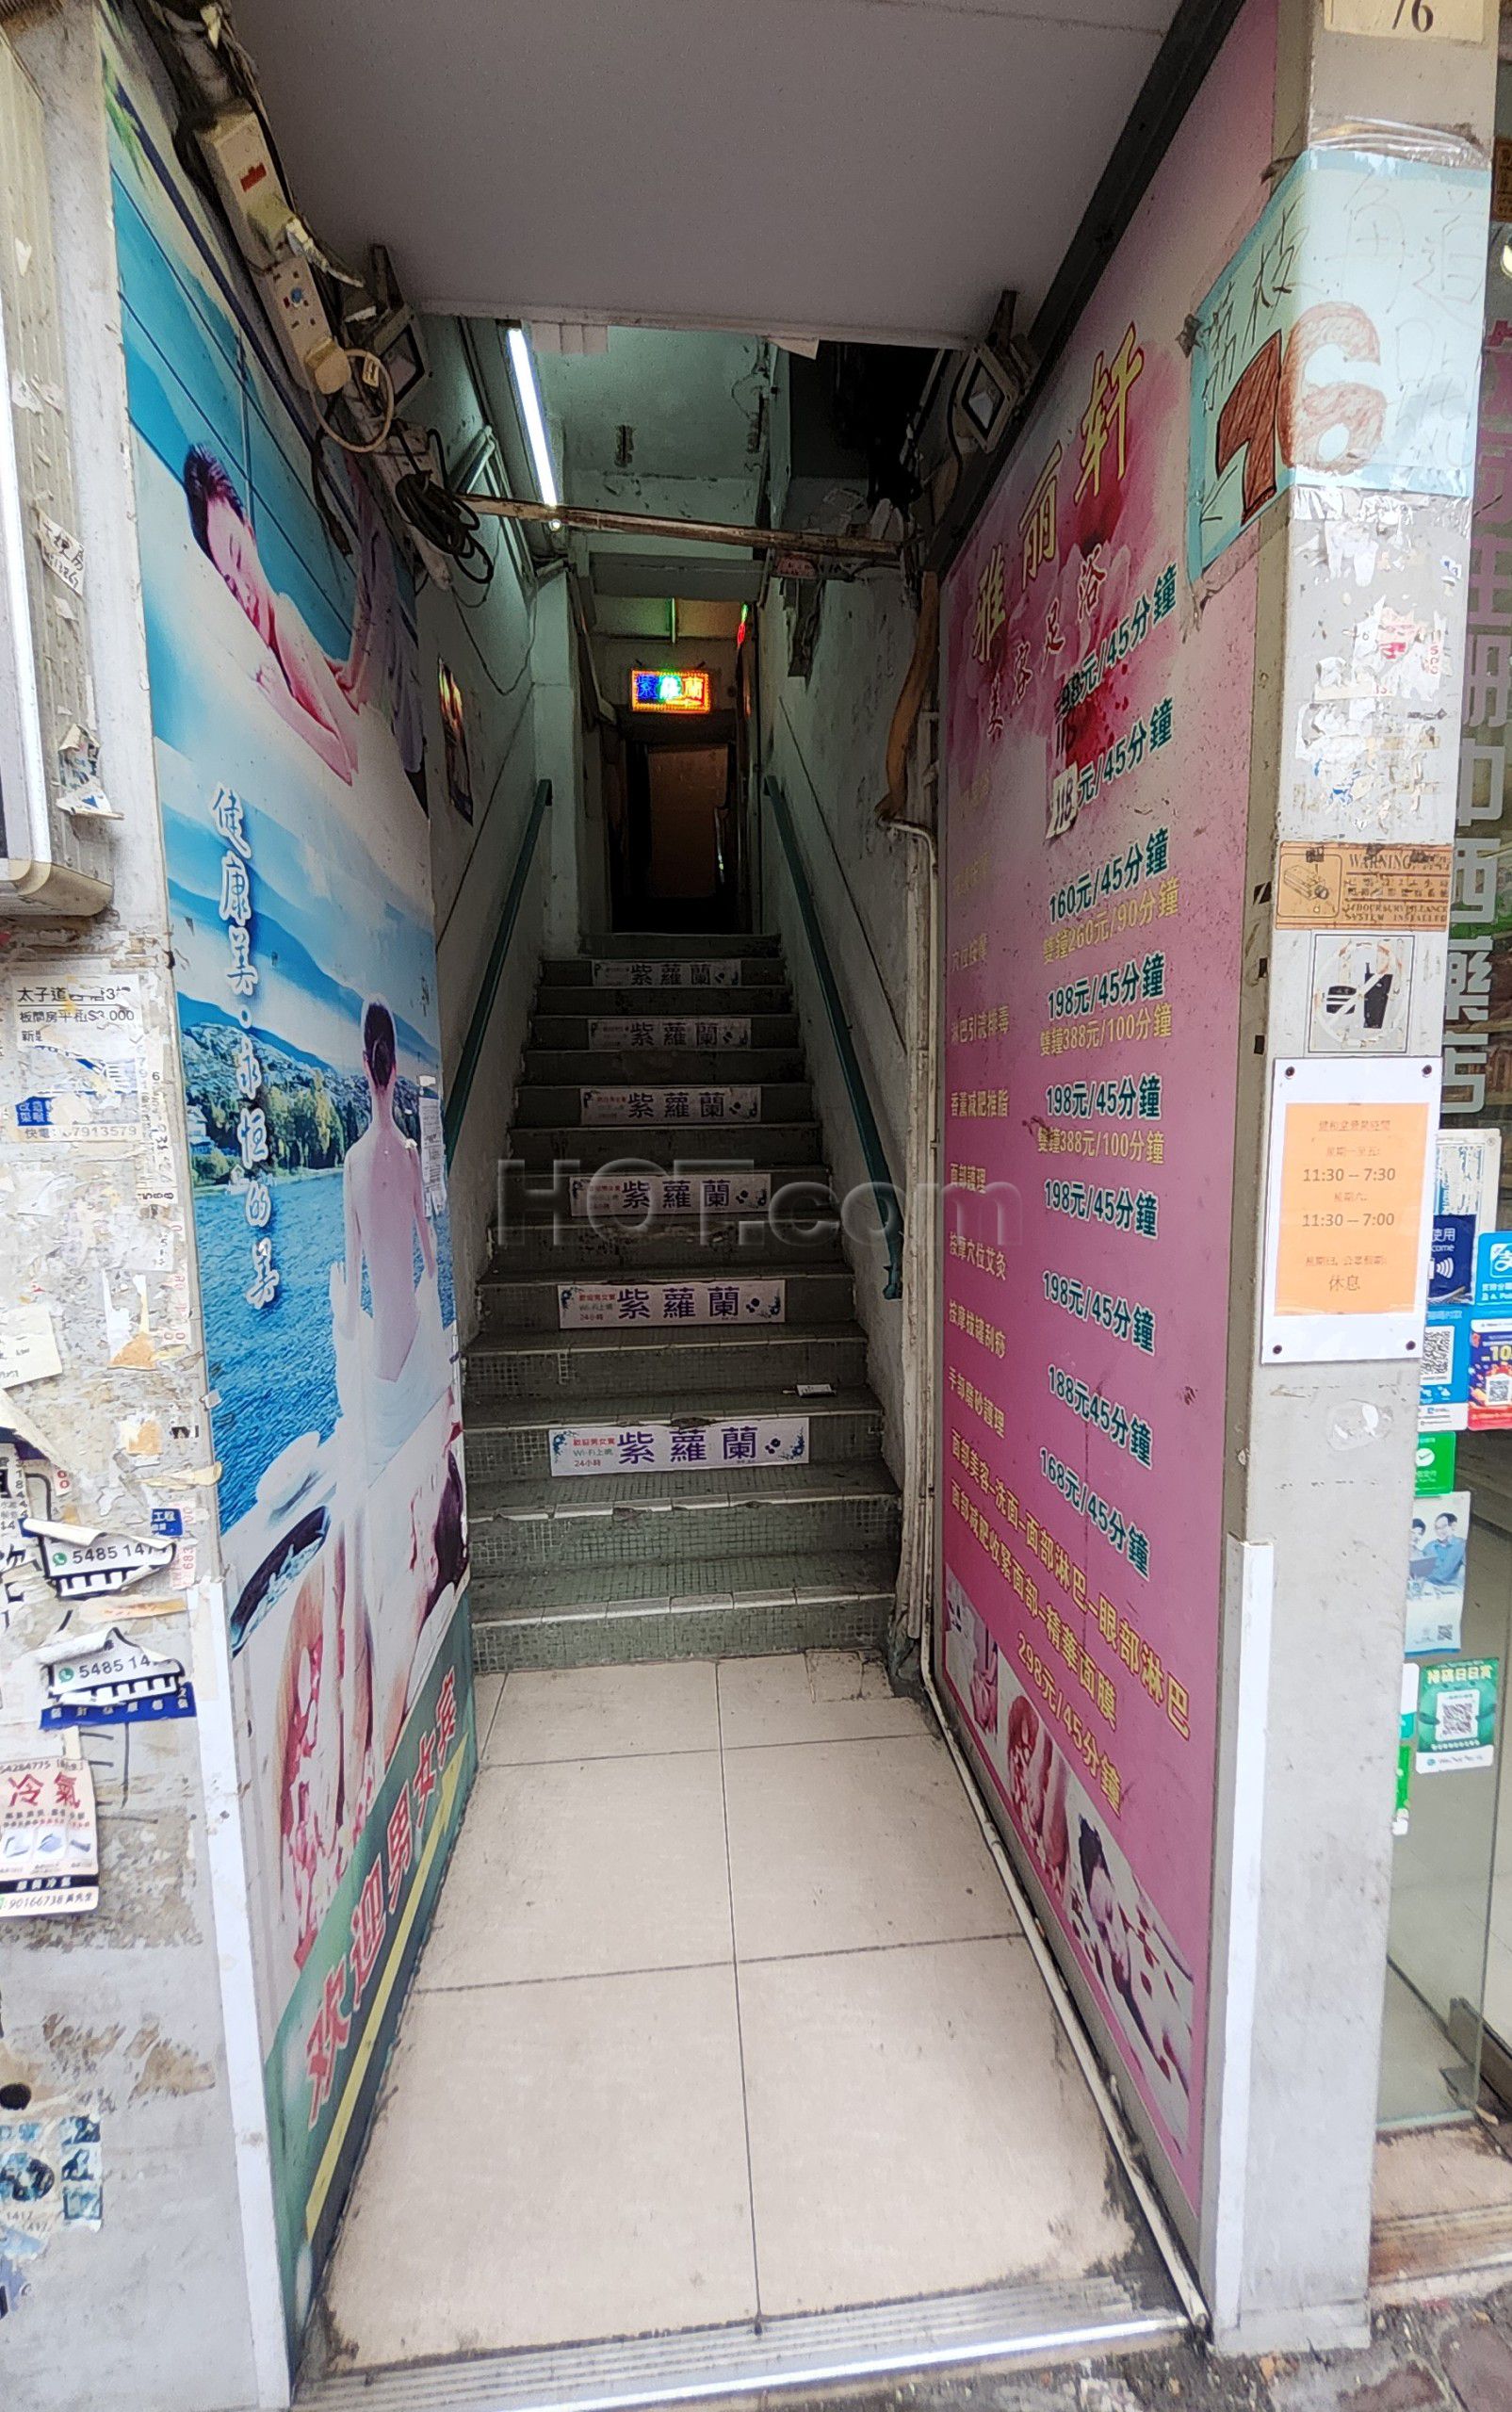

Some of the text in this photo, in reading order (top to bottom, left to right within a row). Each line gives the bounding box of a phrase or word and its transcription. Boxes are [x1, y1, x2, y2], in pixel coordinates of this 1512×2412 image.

[1049, 828, 1169, 923] 160元/45分鐘
[630, 963, 710, 986] 紫蘿蘭
[1048, 951, 1165, 1020] 198元/45分鐘
[630, 1022, 719, 1047] 紫蘿蘭
[626, 1092, 725, 1118] 紫蘿蘭
[1046, 1072, 1161, 1119] 198元/45分鐘
[1303, 1168, 1344, 1182] 11:30
[1364, 1167, 1396, 1182] 7:30
[622, 1180, 730, 1210] 紫蘿蘭
[1045, 1179, 1158, 1239] 198元/45分鐘
[1302, 1214, 1343, 1227] 11:30
[1363, 1213, 1394, 1226] 7:00
[1328, 1275, 1361, 1292] 休息
[617, 1286, 740, 1319] 紫蘿蘭
[1043, 1270, 1155, 1356] 198元/45分鐘
[1049, 1364, 1152, 1470] 188元45分鐘
[617, 1426, 757, 1464] 紫蘿蘭
[574, 1459, 602, 1468] 24小時
[1040, 1446, 1150, 1582] 168元/45分鐘
[73, 1546, 118, 1564] 5485
[79, 1660, 124, 1679] 5485
[1017, 1630, 1121, 1819] 298元/45分鐘
[8, 1772, 81, 1809] 冷氣
[307, 1667, 456, 2131] 欢迎男女宾
